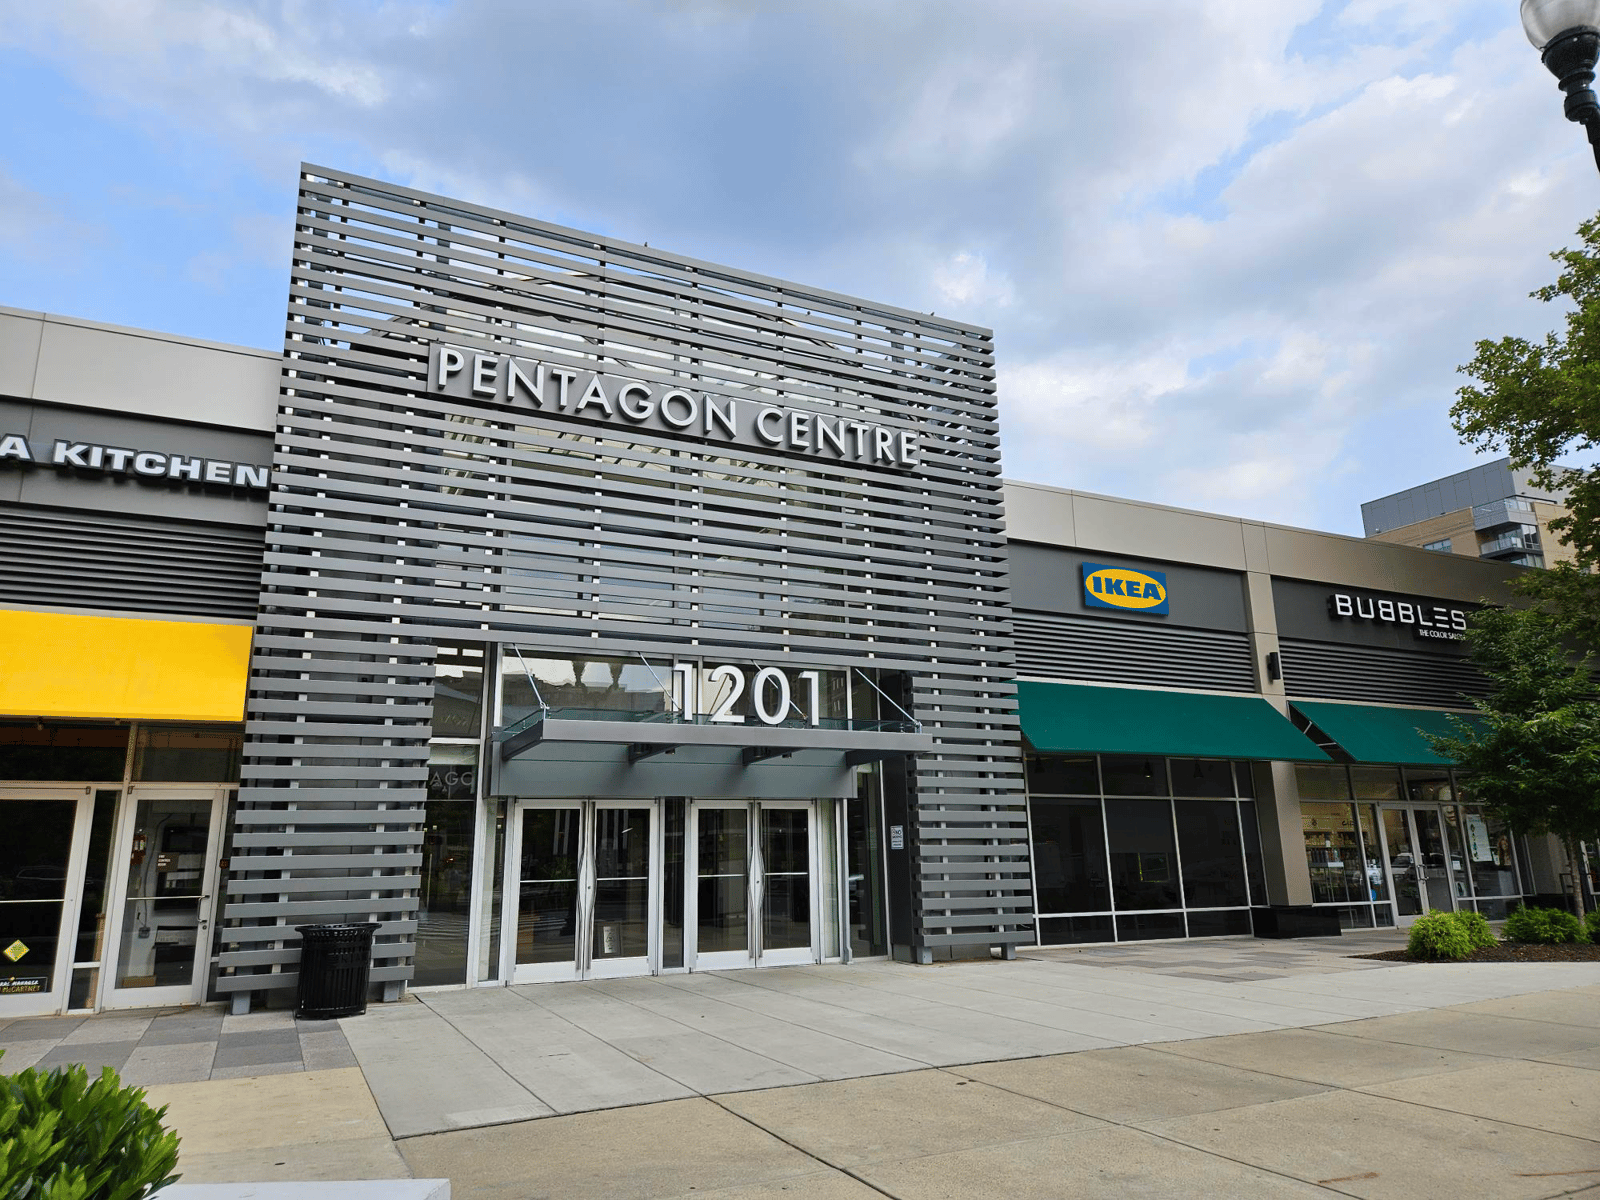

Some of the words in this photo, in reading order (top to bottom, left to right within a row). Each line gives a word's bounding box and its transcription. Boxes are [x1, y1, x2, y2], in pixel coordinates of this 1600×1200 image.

[438, 347, 737, 438] PENTAGON
[754, 407, 919, 466] CENTRE
[0, 436, 32, 460] A
[53, 440, 270, 488] KITCHEN
[1092, 576, 1162, 600] IKEA
[1335, 594, 1467, 630] BUBBLES
[1419, 629, 1429, 637] THE
[1430, 630, 1448, 639] COLOR
[672, 663, 820, 726] 1201
